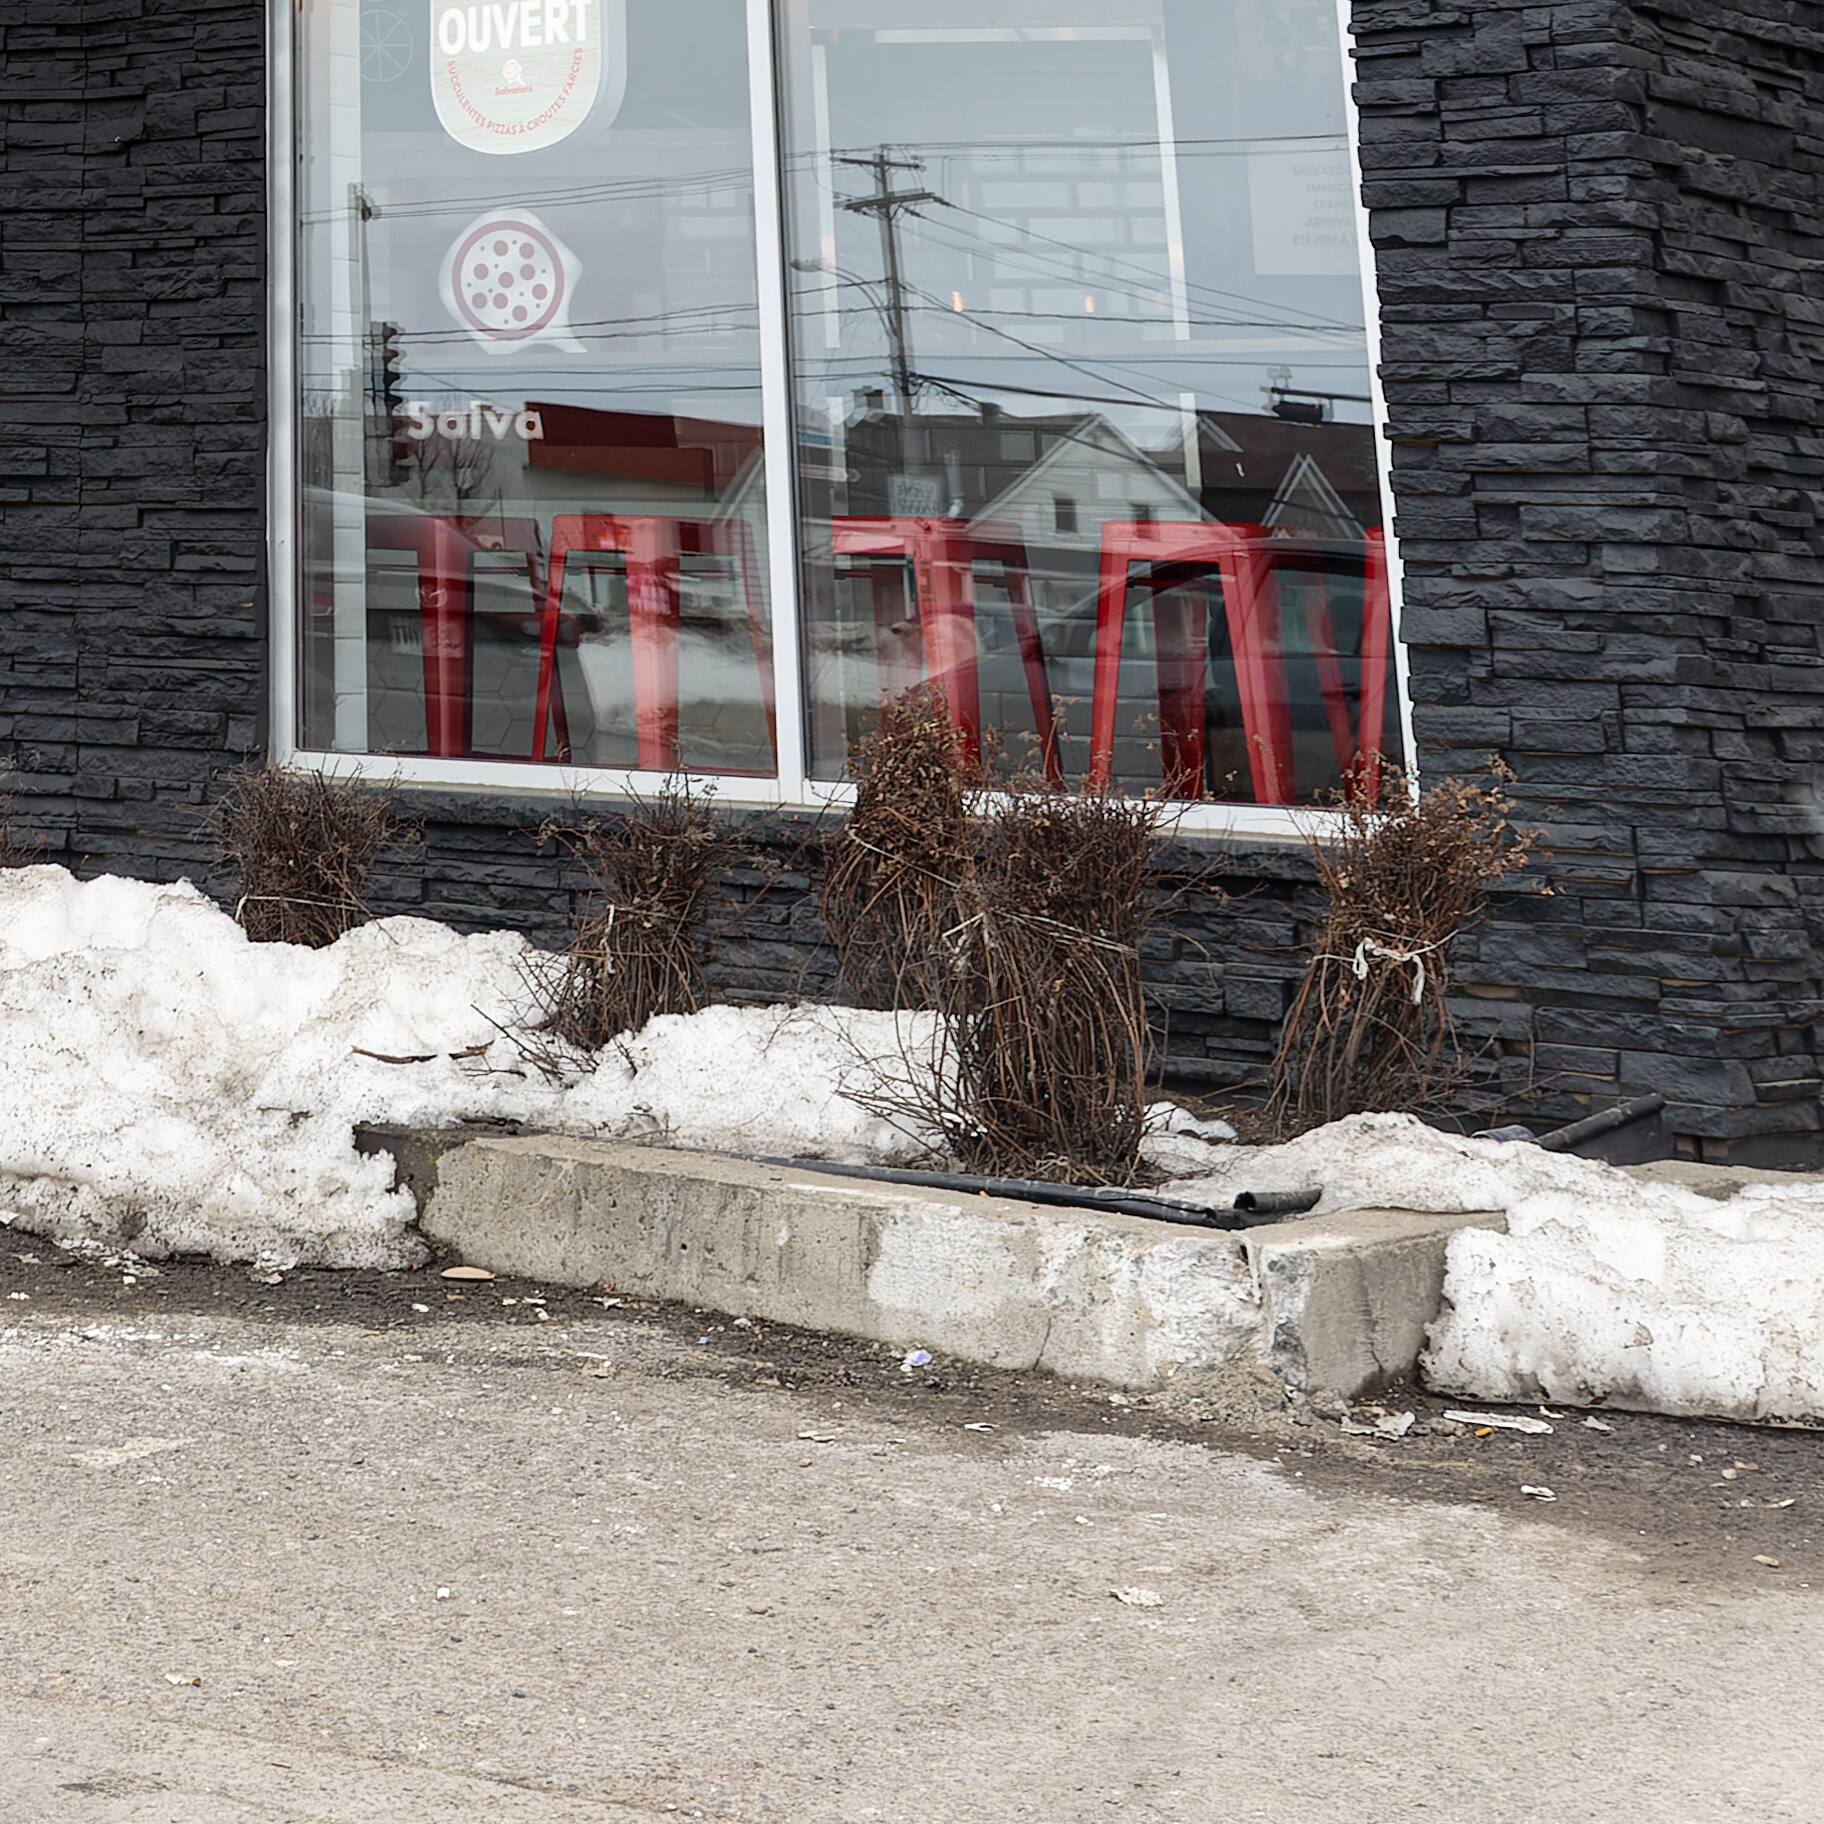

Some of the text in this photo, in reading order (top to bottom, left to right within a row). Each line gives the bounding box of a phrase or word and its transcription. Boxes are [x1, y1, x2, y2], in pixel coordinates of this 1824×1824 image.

[447, 59, 487, 128] SUCCULENTES
[487, 120, 517, 136] PIZZAS
[563, 47, 583, 96] FARCIES
